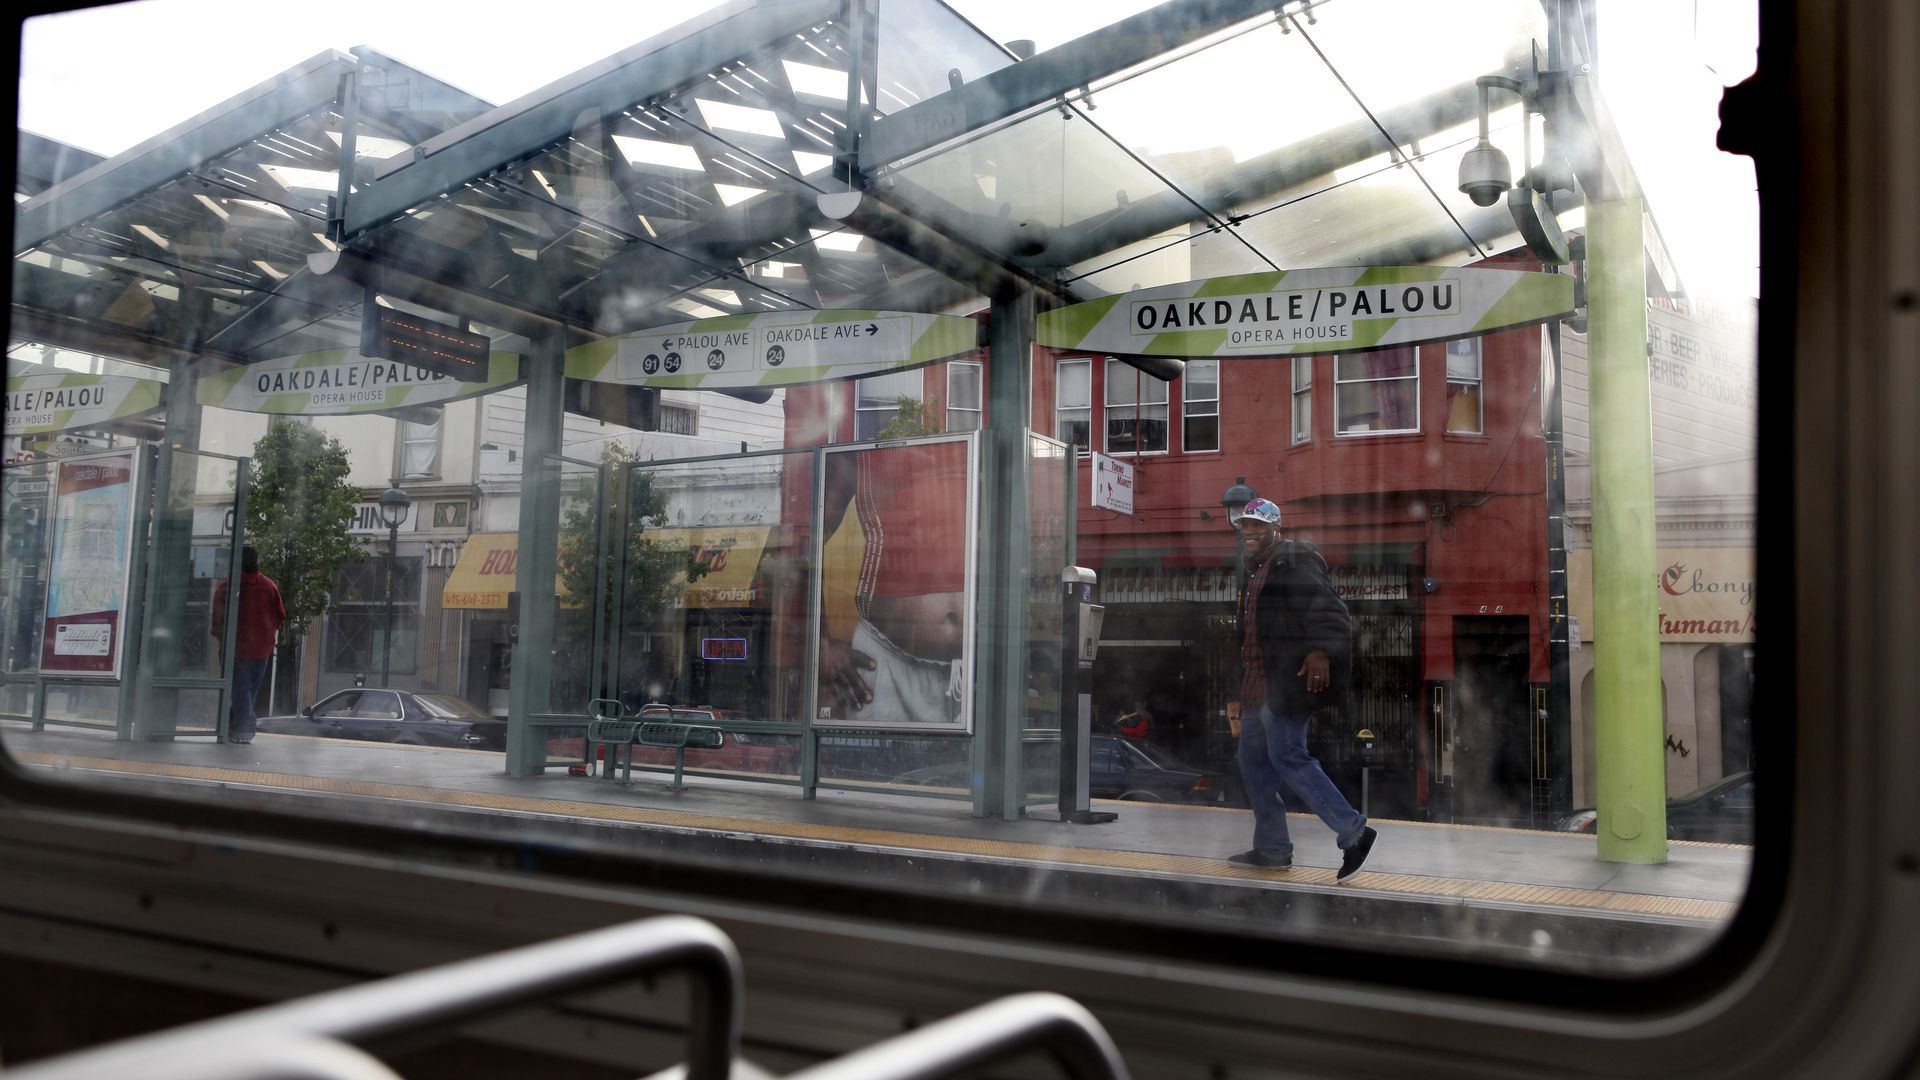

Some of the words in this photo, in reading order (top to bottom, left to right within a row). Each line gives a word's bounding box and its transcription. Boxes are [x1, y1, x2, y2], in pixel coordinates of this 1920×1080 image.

[1137, 284, 1452, 330] OAKDALE/PALOU
[678, 335, 719, 349] PALOU
[724, 333, 749, 347] AVE
[766, 327, 828, 343] OAKDALE
[834, 324, 860, 338] AVE
[1231, 328, 1284, 344] OPERA
[1293, 324, 1348, 339] HOUSE
[1670, 333, 1702, 364] BEER
[313, 393, 345, 405] OPERA
[350, 390, 383, 401] HOUSE
[25, 414, 52, 424] HOUSE
[705, 640, 745, 658] OPEN
